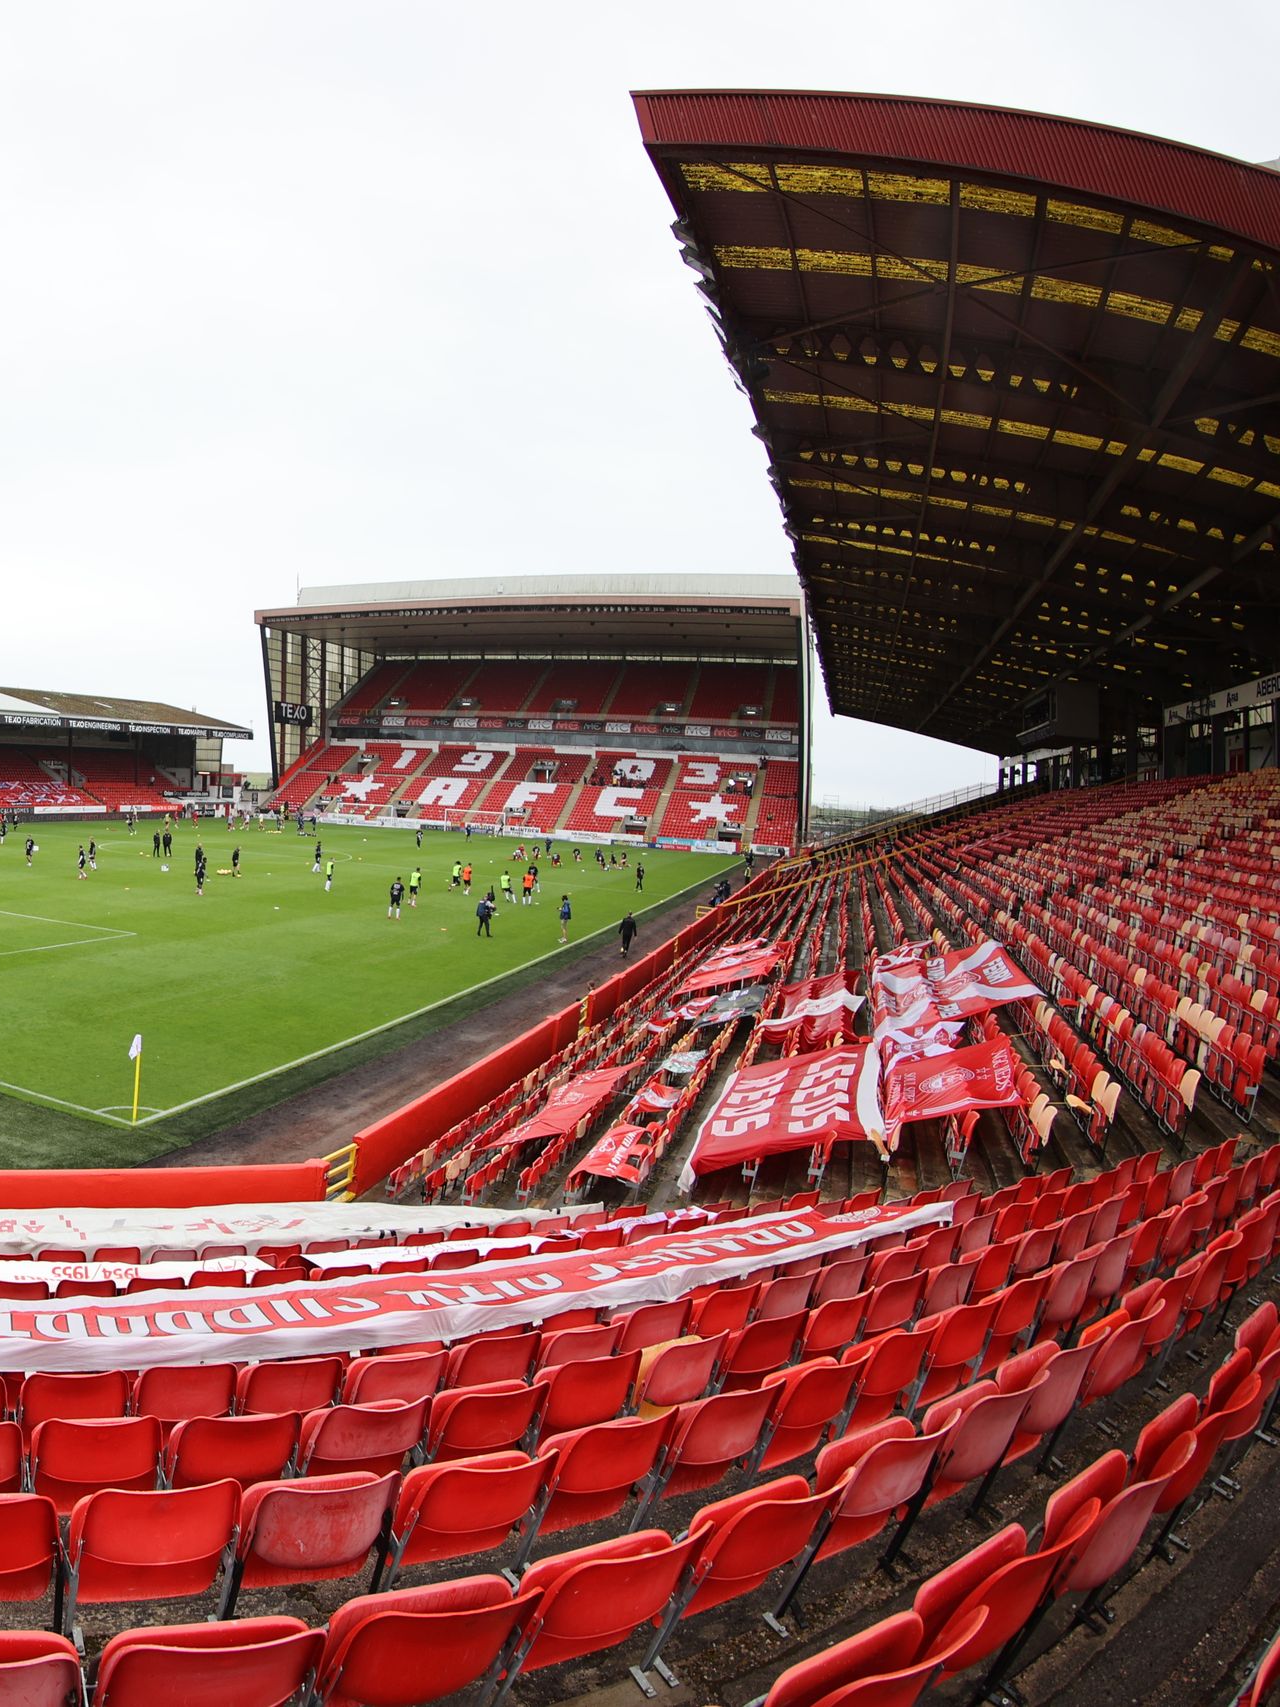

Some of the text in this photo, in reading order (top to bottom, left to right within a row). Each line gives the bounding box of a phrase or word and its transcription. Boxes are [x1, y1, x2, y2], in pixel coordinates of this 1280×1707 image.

[281, 702, 307, 720] TEXO
[4, 715, 61, 726] TEXO FABRICATION
[84, 721, 121, 731] ENGINEERING
[787, 1052, 858, 1133] LEEDS
[711, 1068, 789, 1137] REDS
